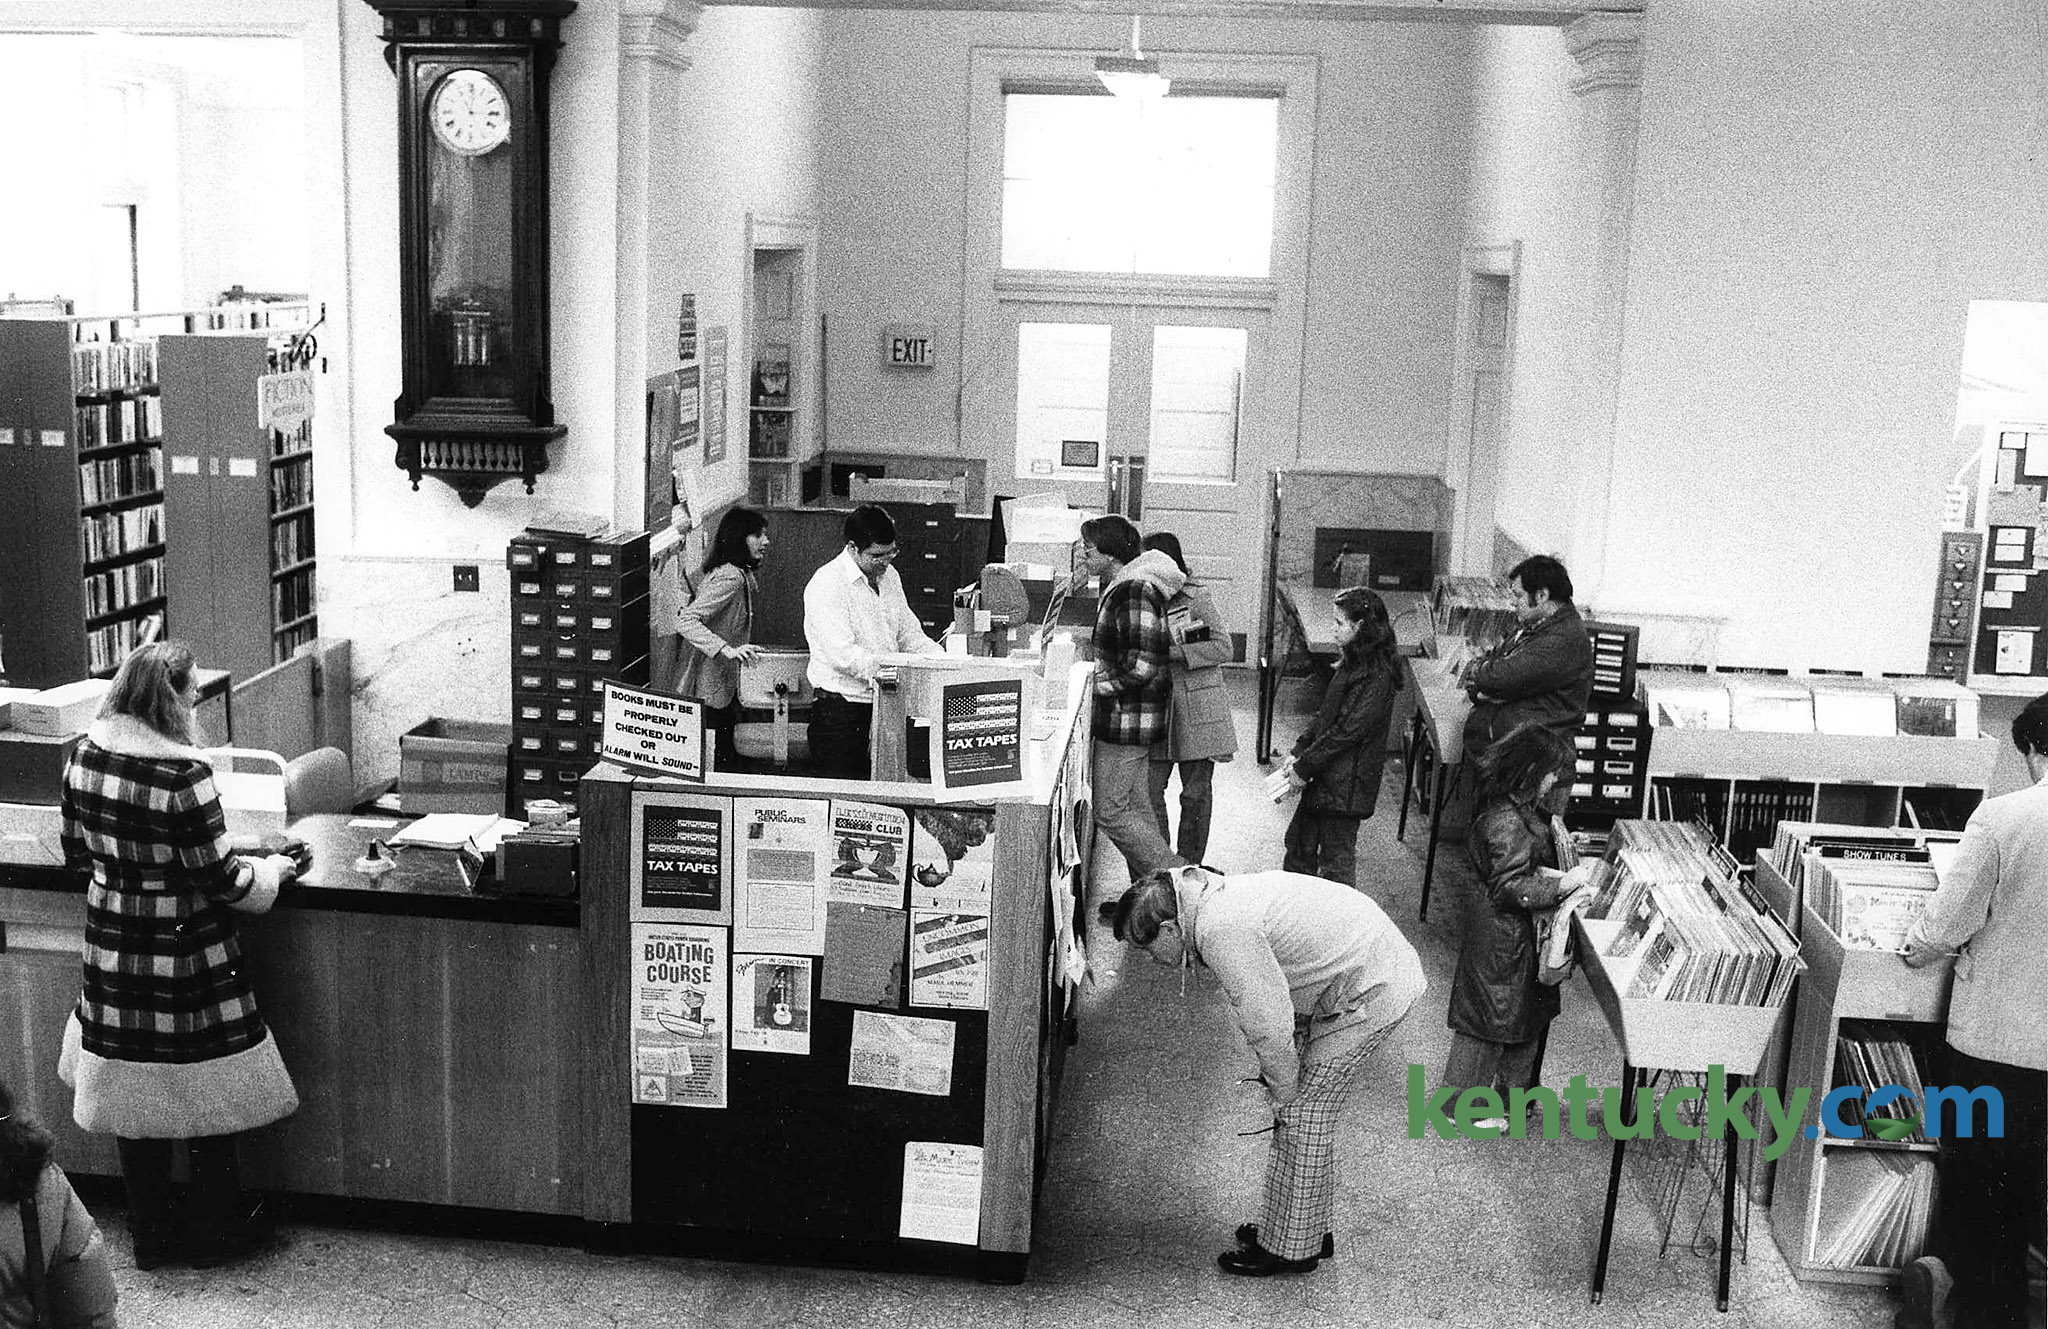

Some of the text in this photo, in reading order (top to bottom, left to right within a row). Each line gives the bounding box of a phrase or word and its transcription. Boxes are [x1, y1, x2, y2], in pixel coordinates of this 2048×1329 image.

[893, 338, 928, 363] EXIT
[611, 690, 694, 715] BOOKS MUST BE
[624, 709, 678, 727] PROPERLY
[615, 722, 688, 744] CHECKED OUT
[946, 733, 1018, 751] TAX TAPES
[640, 740, 656, 750] OR
[604, 744, 632, 758] ALARM
[633, 751, 659, 765] WILL
[755, 809, 807, 824] PUBLIC SEMINARS
[876, 824, 902, 836] CLUB
[1843, 849, 1907, 862] SHOW TUNES
[647, 860, 719, 875] TAX TAPES
[644, 942, 714, 965] BOATING
[646, 963, 712, 985] COURSE
